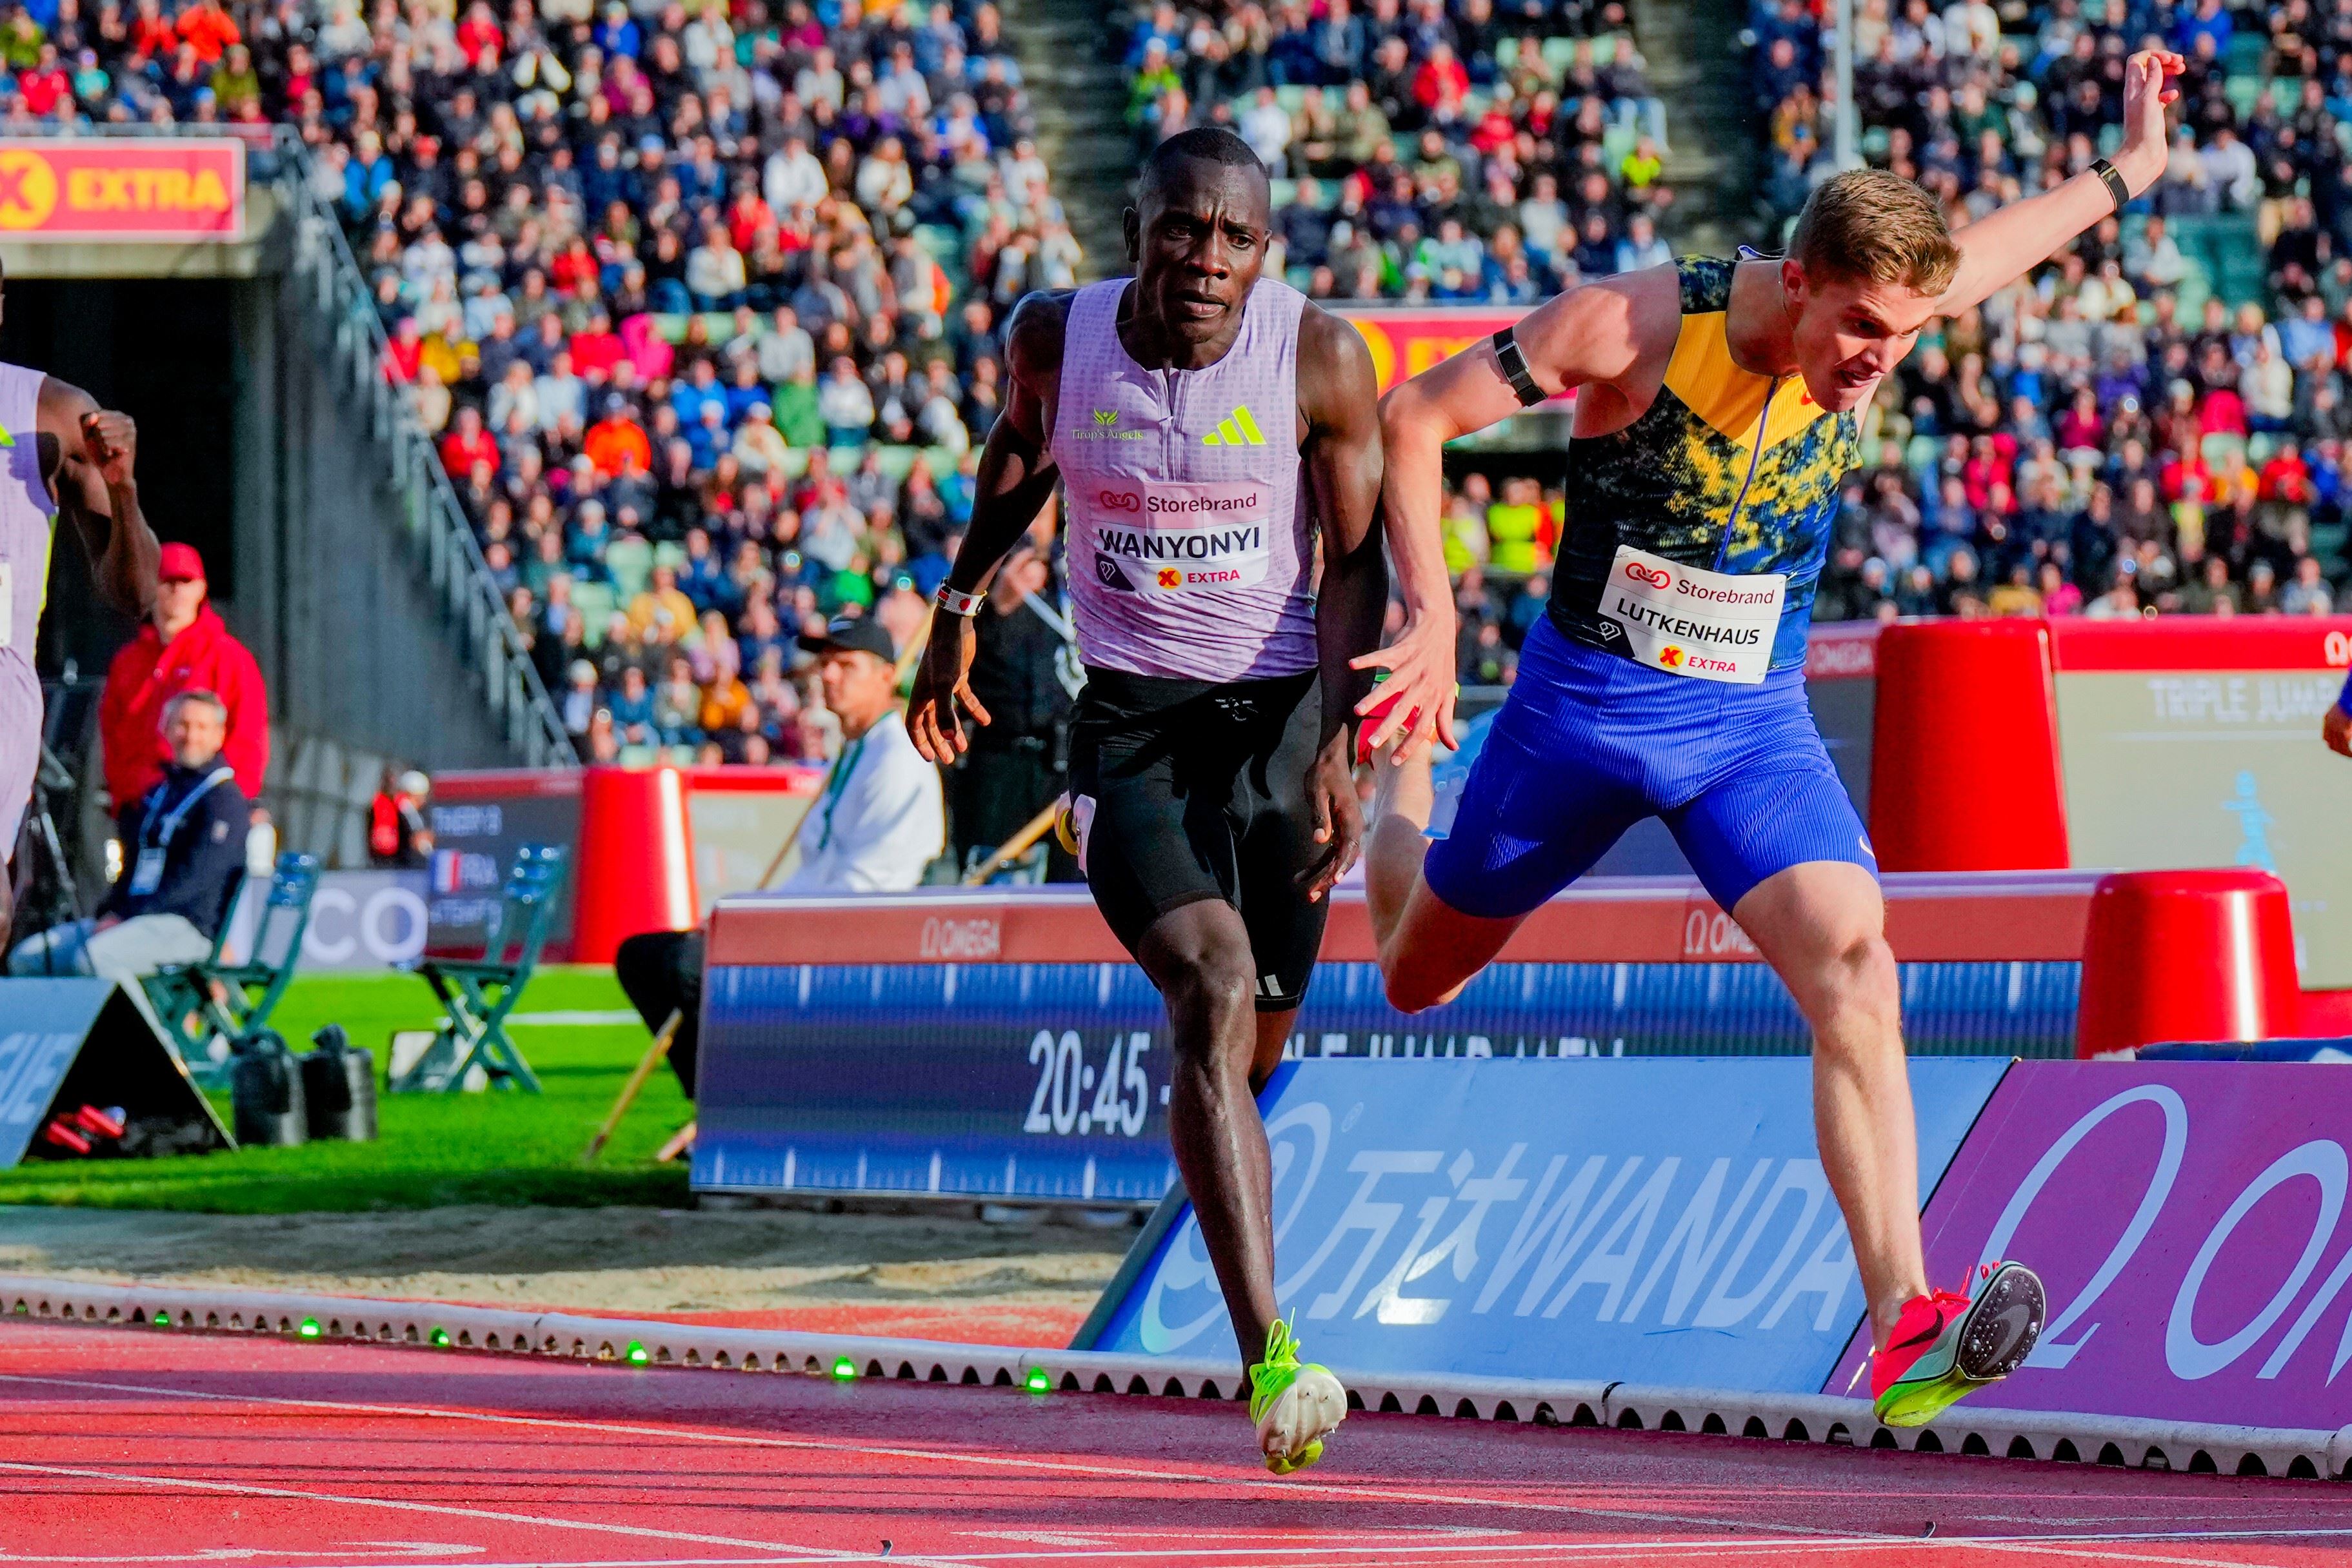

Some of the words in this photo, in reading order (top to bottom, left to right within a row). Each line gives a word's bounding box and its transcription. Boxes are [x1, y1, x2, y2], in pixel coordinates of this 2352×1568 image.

[67, 166, 228, 212] EXTRA
[1106, 429, 1144, 442] Angels
[1147, 493, 1257, 513] Storebrand
[1098, 526, 1260, 559] WANYONYI
[1188, 569, 1241, 584] EXTRA
[1676, 579, 1775, 604] Storebrand
[1617, 598, 1760, 644] LUTKENHAUS
[1688, 656, 1737, 673] EXTRA
[2148, 679, 2249, 722] TRIPLE
[1024, 1029, 1151, 1137] 20:45
[1471, 1155, 1857, 1332] WANDA
